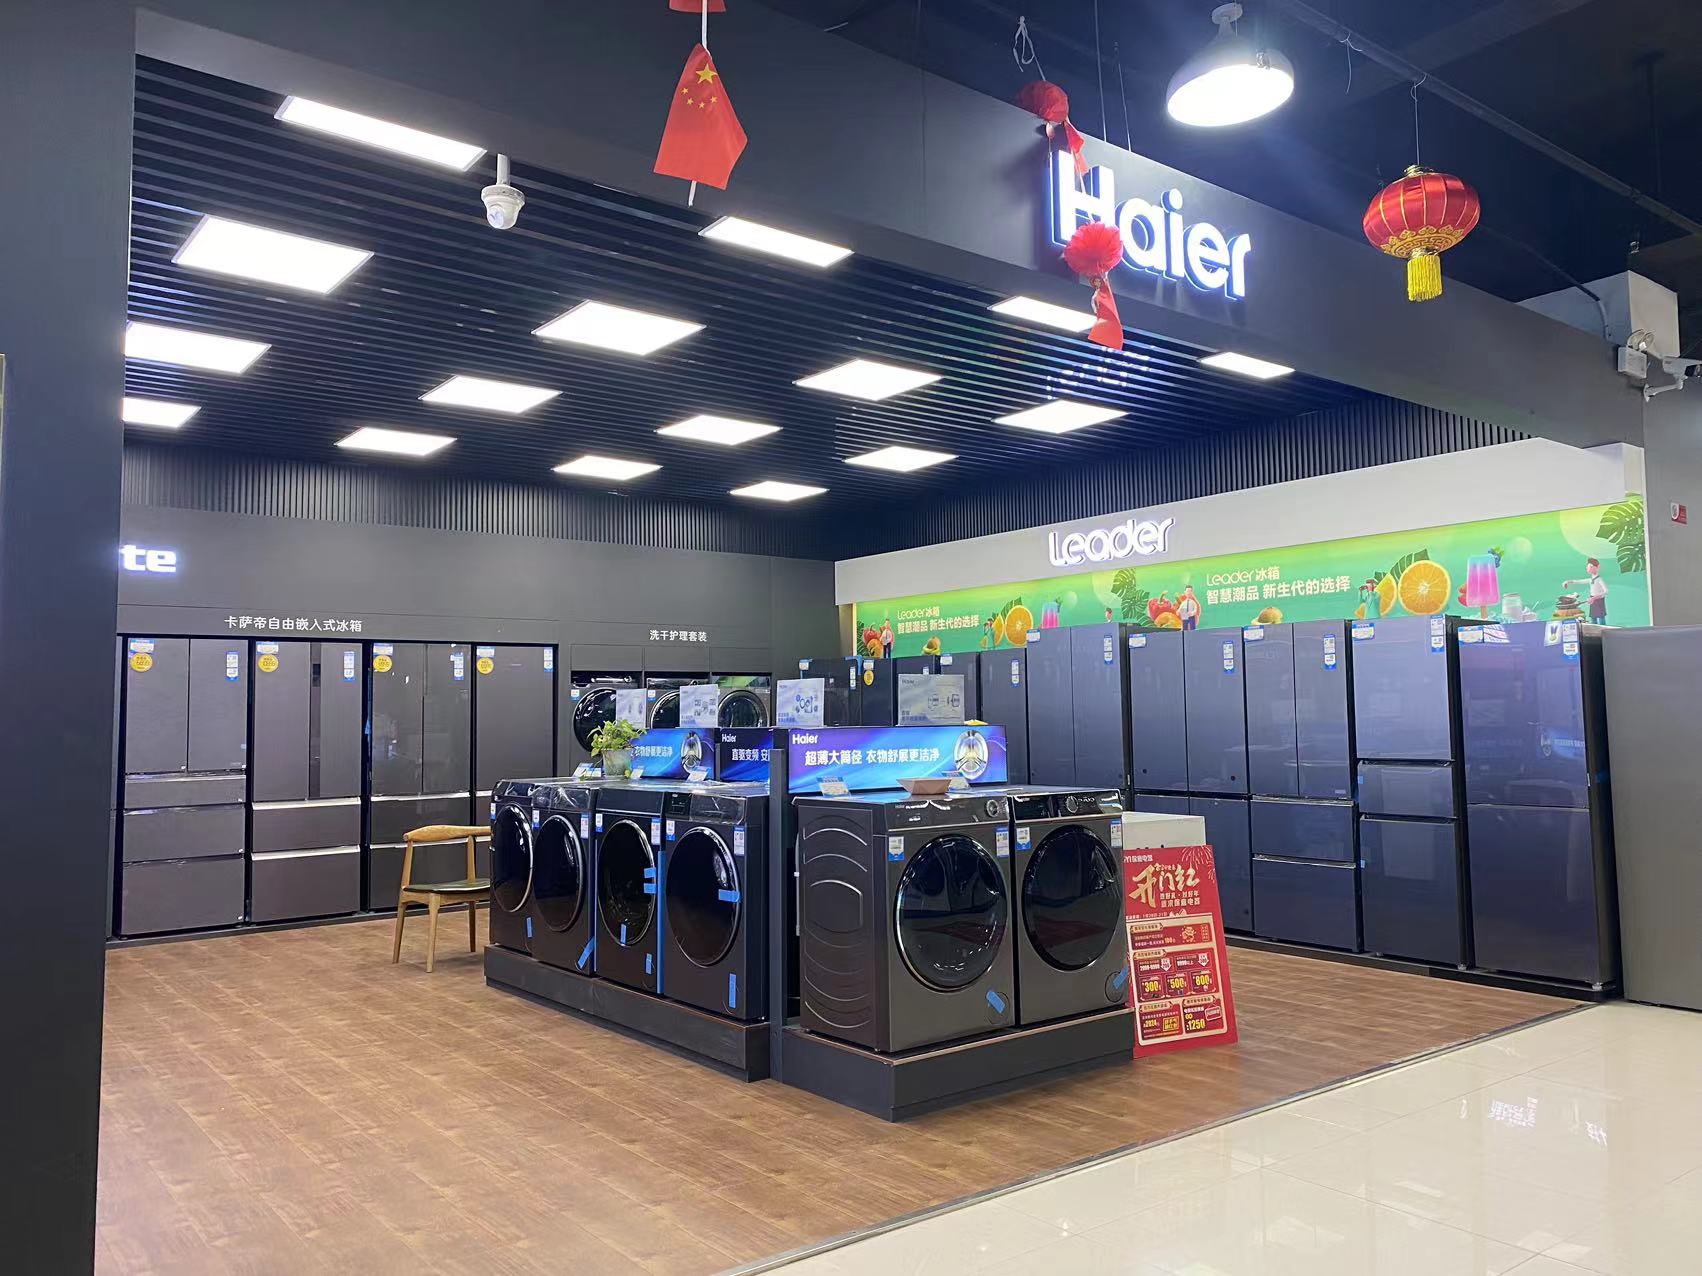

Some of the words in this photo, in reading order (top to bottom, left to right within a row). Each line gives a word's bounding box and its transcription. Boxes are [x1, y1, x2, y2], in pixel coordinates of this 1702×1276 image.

[1049, 149, 1252, 300] Haier
[1048, 517, 1176, 567] Leader
[1206, 586, 1260, 605] 智慧潮品
[1263, 575, 1351, 600] 新生代的选择
[224, 616, 362, 633] 卡萨帝自由嵌入式冰箱
[930, 614, 980, 631] 新生代的选择
[649, 629, 708, 642] 洗干护理套装
[721, 733, 737, 743] Haier
[792, 734, 819, 745] Haier
[731, 749, 760, 761] 直驱变频
[760, 748, 770, 761] 安
[804, 749, 863, 766] 超薄大筒径
[866, 747, 940, 764] 衣物舒展更洁净
[1128, 864, 1200, 908] 开门红
[1188, 1019, 1206, 1031] 1250
